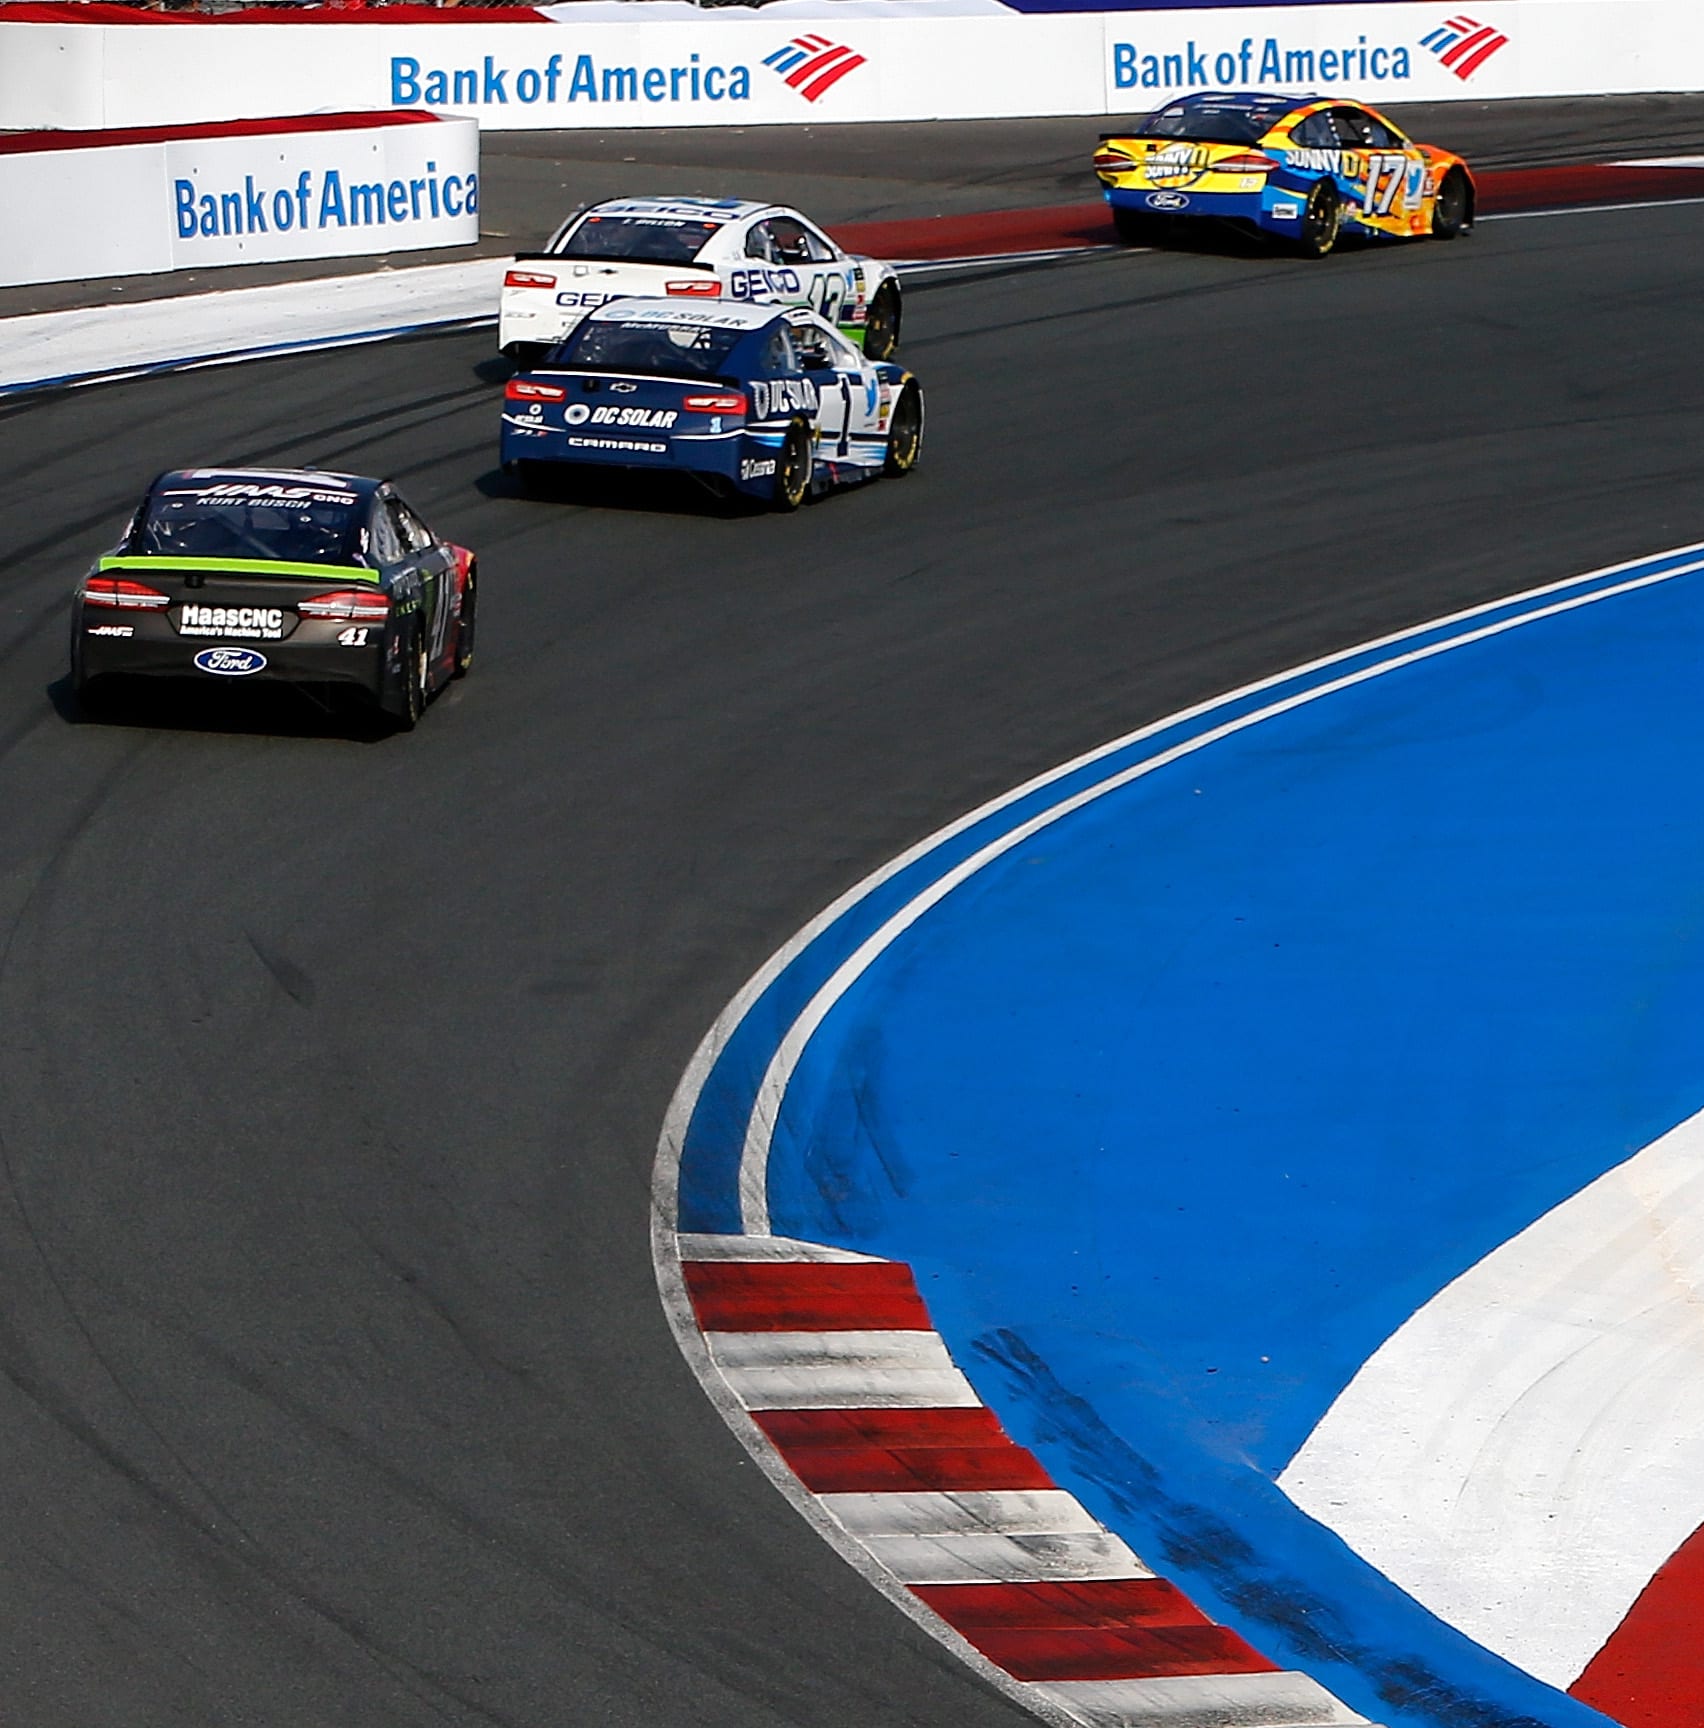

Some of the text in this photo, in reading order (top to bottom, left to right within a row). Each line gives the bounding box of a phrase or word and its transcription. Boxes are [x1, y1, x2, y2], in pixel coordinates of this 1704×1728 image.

[1114, 36, 1409, 89] Bank of America
[391, 53, 751, 105] Bank of America
[1363, 155, 1407, 218] 17
[174, 161, 478, 240] Bank of America
[731, 269, 800, 298] GEICO
[591, 407, 678, 429] DC SOLAR
[710, 416, 722, 434] 1
[568, 437, 667, 453] CAMARO
[248, 498, 312, 510] BUSCH
[181, 605, 282, 628] HaasCNC
[180, 625, 223, 637] America's
[338, 627, 369, 646] 41
[206, 650, 253, 671] Ford
